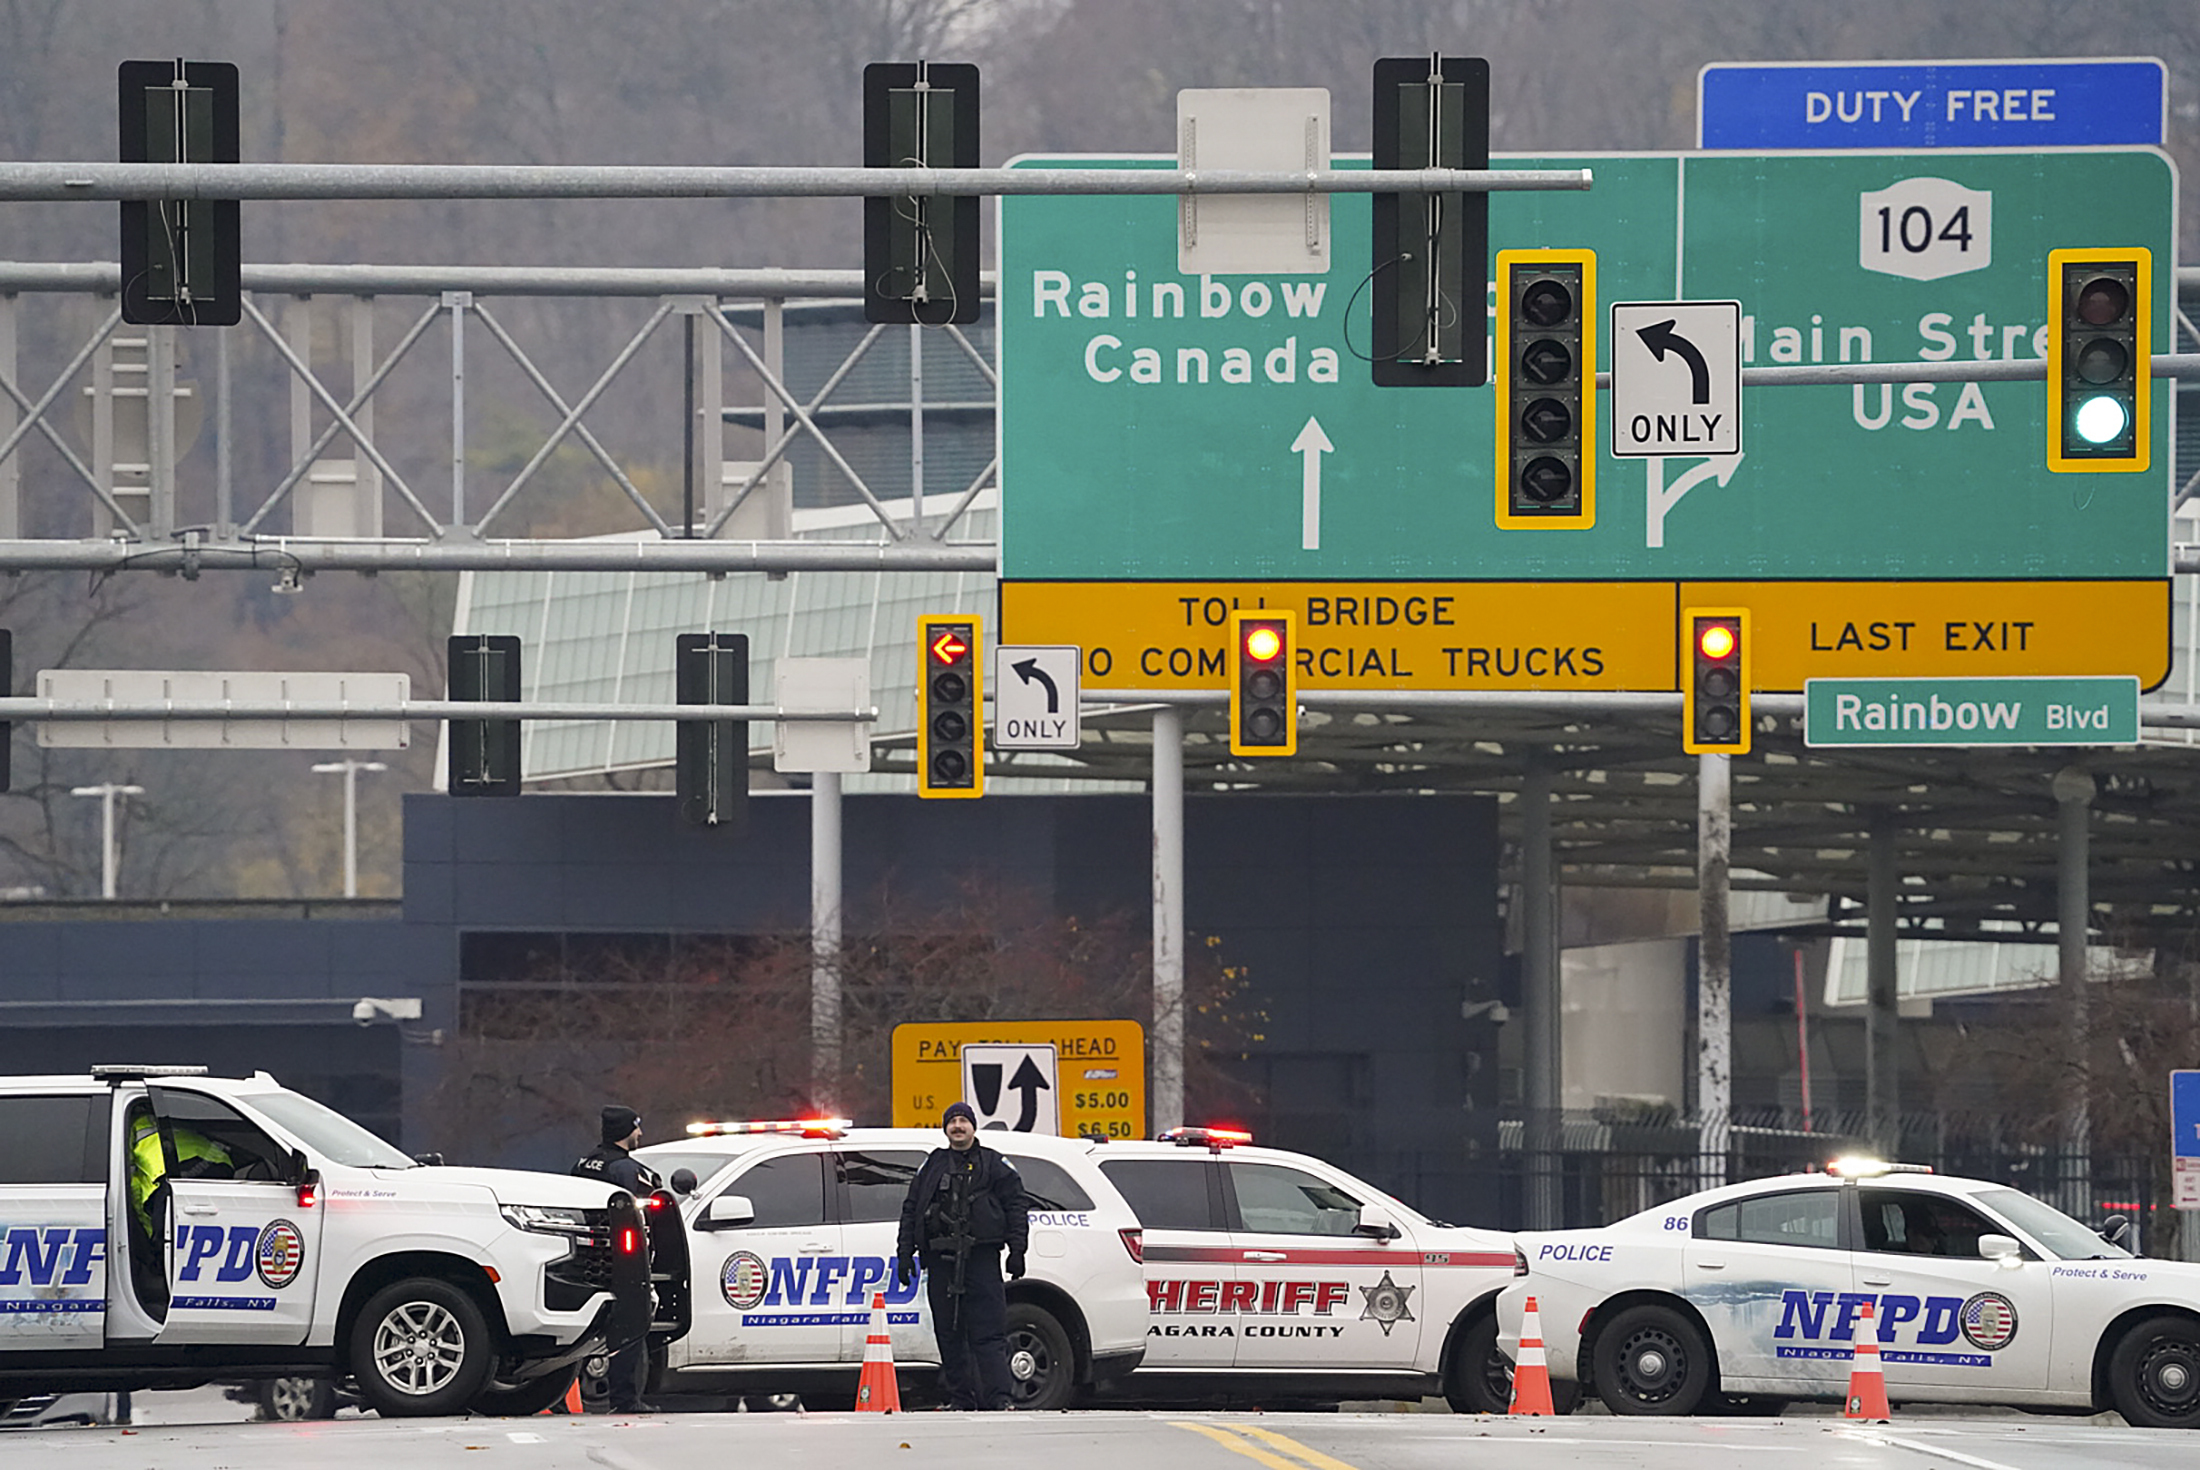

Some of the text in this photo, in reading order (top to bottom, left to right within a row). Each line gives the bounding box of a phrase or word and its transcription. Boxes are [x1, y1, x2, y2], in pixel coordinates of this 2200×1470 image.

[1807, 89, 2056, 123] DUTY FREE
[1877, 205, 1973, 254] 104
[1033, 270, 1327, 319] Rainbow
[1084, 334, 1340, 384] Canada
[1853, 382, 1995, 431] USA
[1631, 414, 1722, 443] ONLY
[1307, 596, 1456, 626] BRIDGE
[1810, 621, 2036, 652] LAST EXIT
[1080, 646, 1605, 678] O COMRCIAL TRUCKS
[1835, 692, 2110, 731] Rainbow Blvd
[1007, 720, 1068, 740] ONLY
[919, 1040, 961, 1058] PAY
[1075, 1091, 1130, 1109] $5.00
[331, 1189, 363, 1198] Protect
[373, 1190, 397, 1198] Serve
[1027, 1213, 1090, 1227] POLICE
[1663, 1216, 1689, 1231] 86
[1539, 1244, 1614, 1261] POLICE
[2052, 1266, 2148, 1282] Protect & Serve
[6, 1302, 105, 1312] Niagara
[247, 1299, 273, 1309] NY
[1147, 1280, 1350, 1316] HERIFF
[748, 1314, 916, 1325] Niagara Fall NY
[1773, 1290, 1965, 1345] NFPD
[1244, 1325, 1345, 1338] COUNTY
[1958, 1354, 1986, 1365] NY
